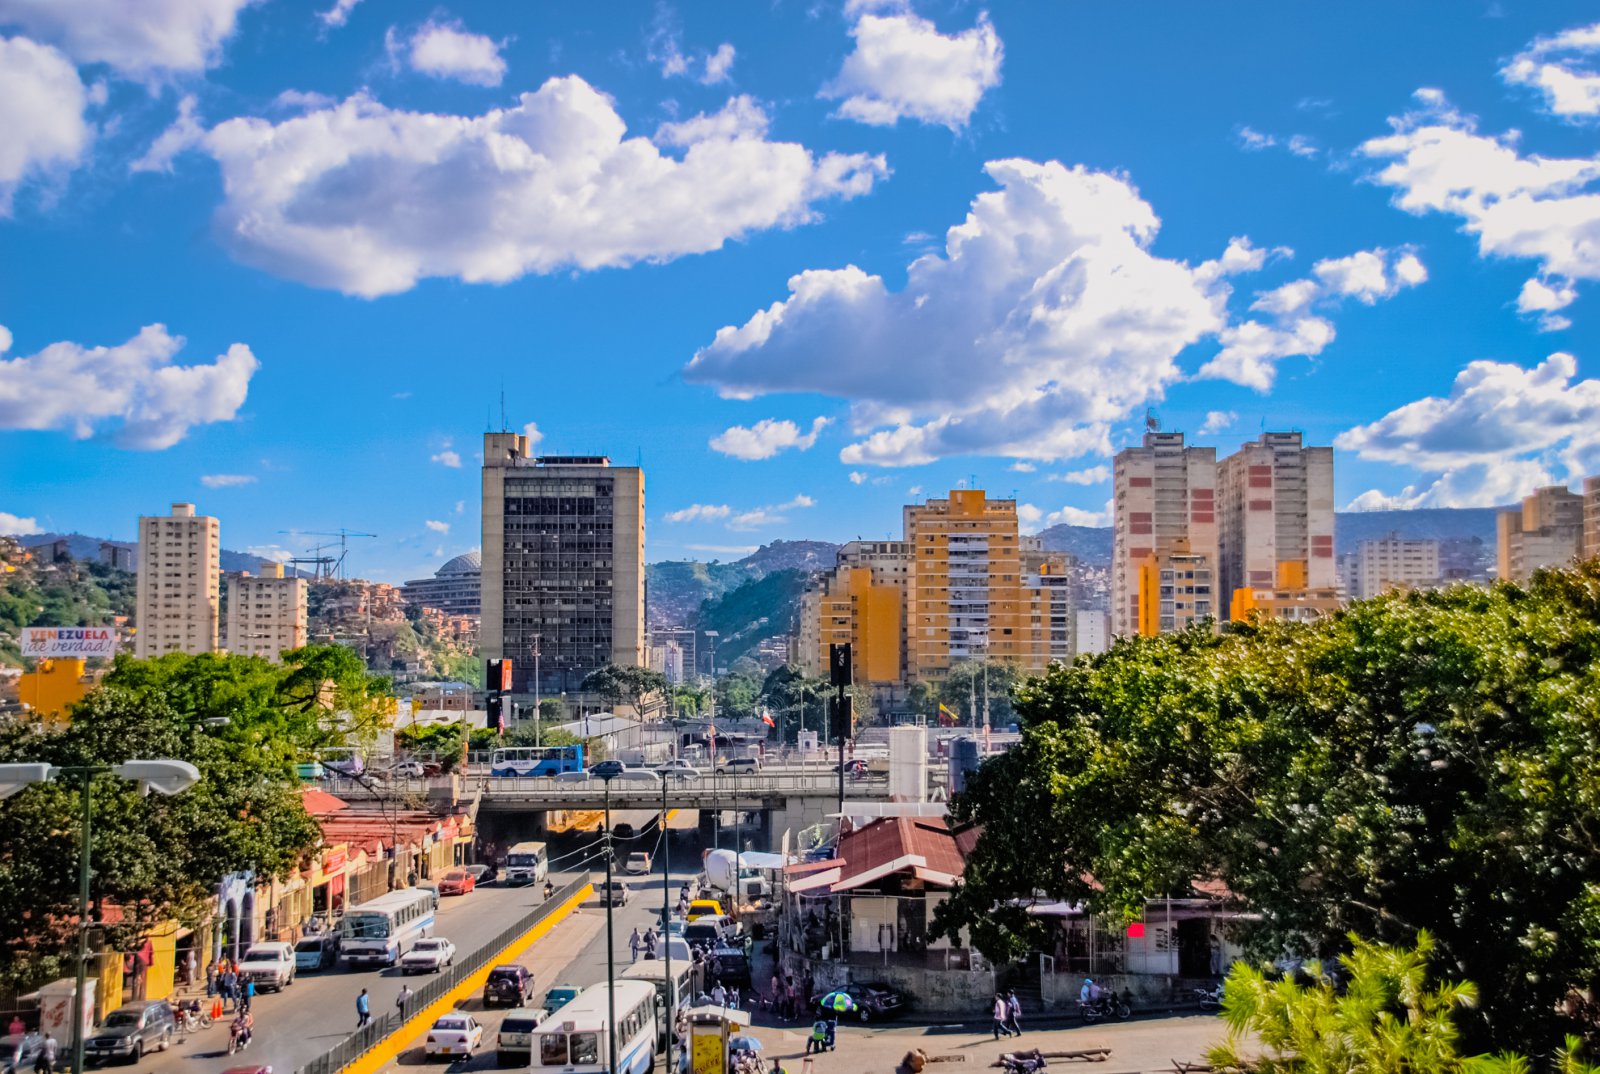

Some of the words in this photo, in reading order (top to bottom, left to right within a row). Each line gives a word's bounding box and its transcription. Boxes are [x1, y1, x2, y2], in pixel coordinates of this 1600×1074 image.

[31, 630, 109, 640] VENEZUELA
[23, 639, 48, 654] ¡de
[52, 639, 113, 653] verdad!
